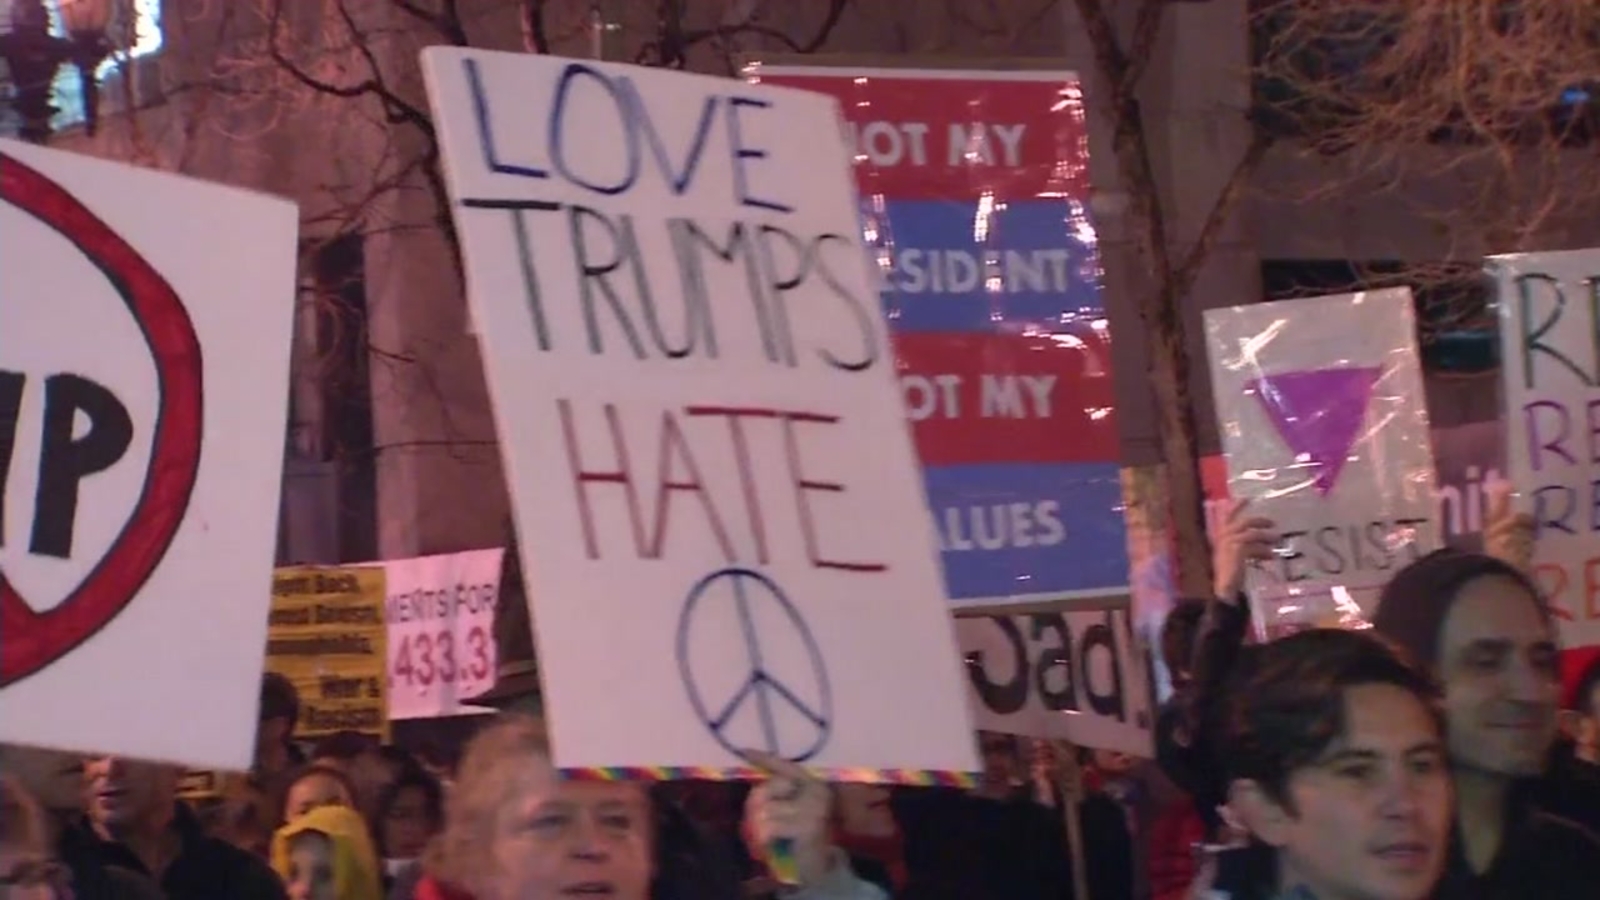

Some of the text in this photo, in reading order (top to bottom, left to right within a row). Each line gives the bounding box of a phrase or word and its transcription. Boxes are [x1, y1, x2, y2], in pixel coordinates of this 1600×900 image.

[462, 58, 795, 212] LOVE
[947, 122, 1028, 168] MY
[461, 198, 879, 371] TRUMPS
[979, 374, 1058, 419] MY
[556, 398, 888, 572] HATE
[940, 499, 1067, 551] LUES
[1250, 517, 1428, 582] ESIST
